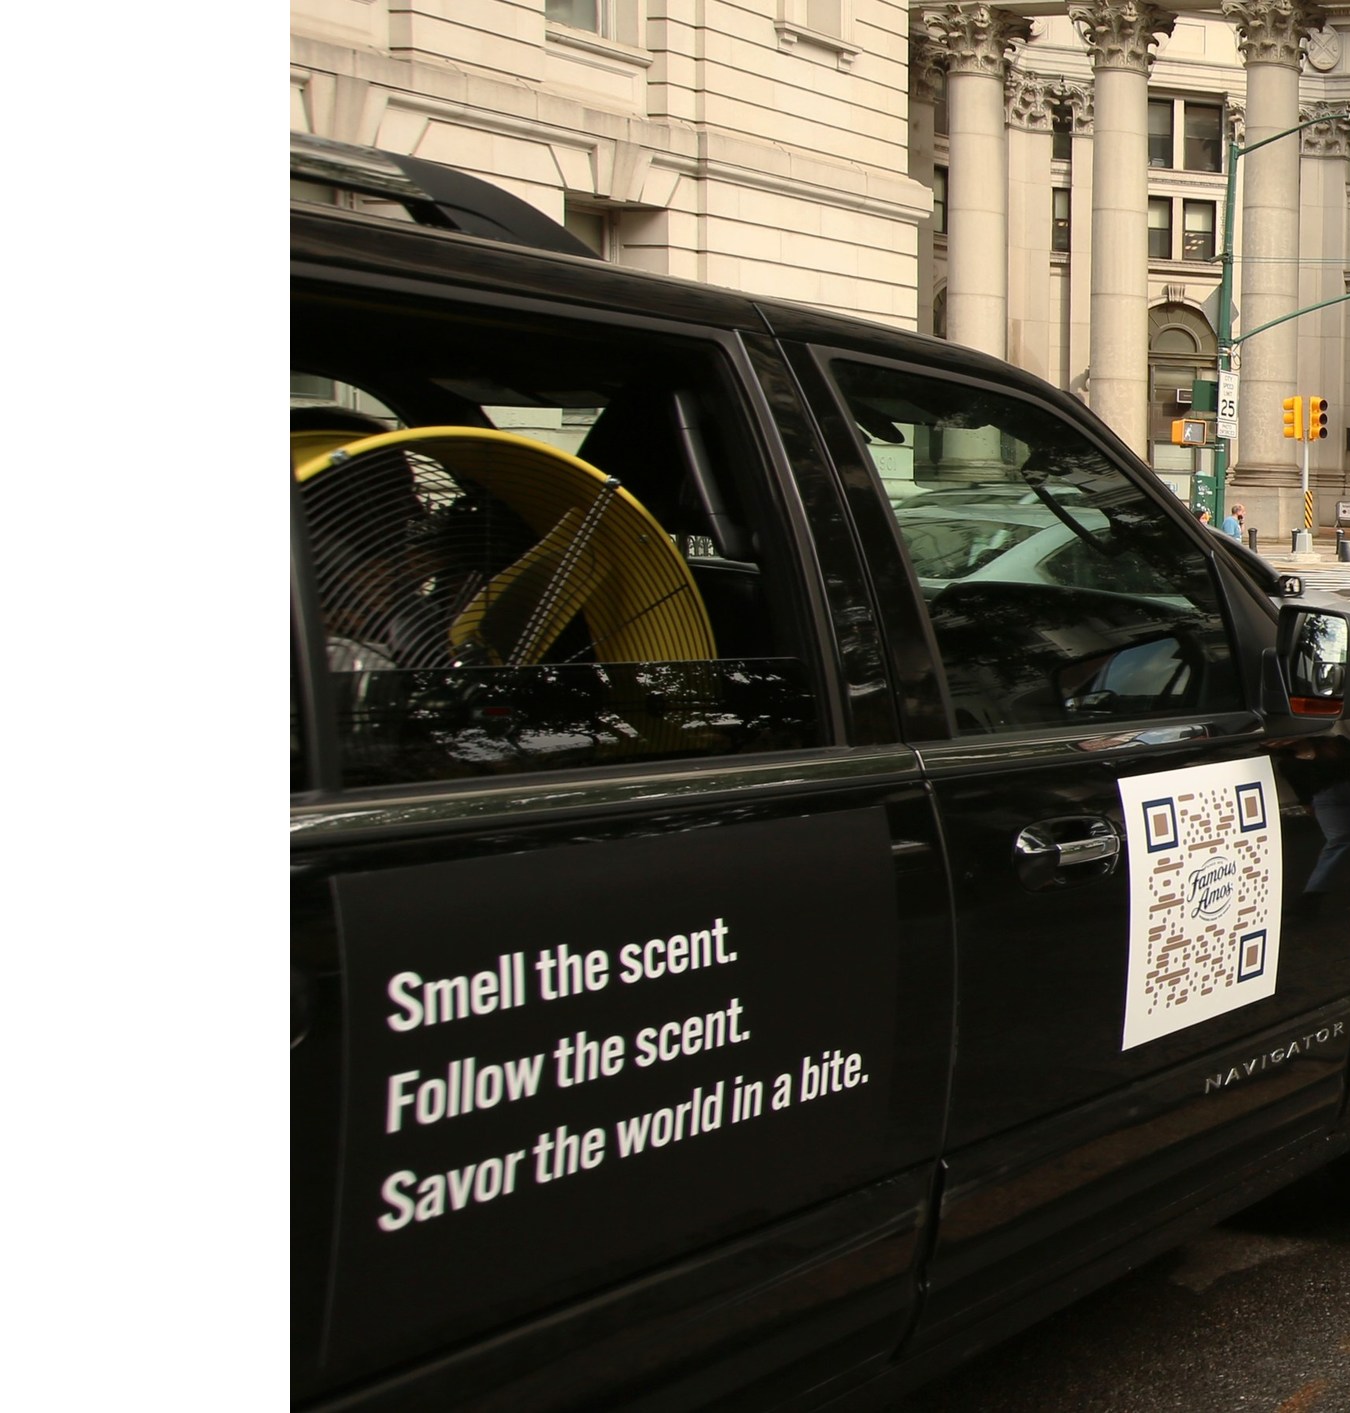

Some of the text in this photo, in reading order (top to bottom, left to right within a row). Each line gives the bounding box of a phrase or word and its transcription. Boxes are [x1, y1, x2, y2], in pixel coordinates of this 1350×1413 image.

[1221, 399, 1235, 417] 25
[1187, 860, 1236, 902] Famous
[1191, 882, 1233, 918] Amos
[387, 917, 738, 1032] Smell the scent.
[386, 998, 751, 1134] Follow the scent.
[1205, 1022, 1344, 1094] NAVIGATOR
[377, 1050, 869, 1232] Savor the world in a bite.
